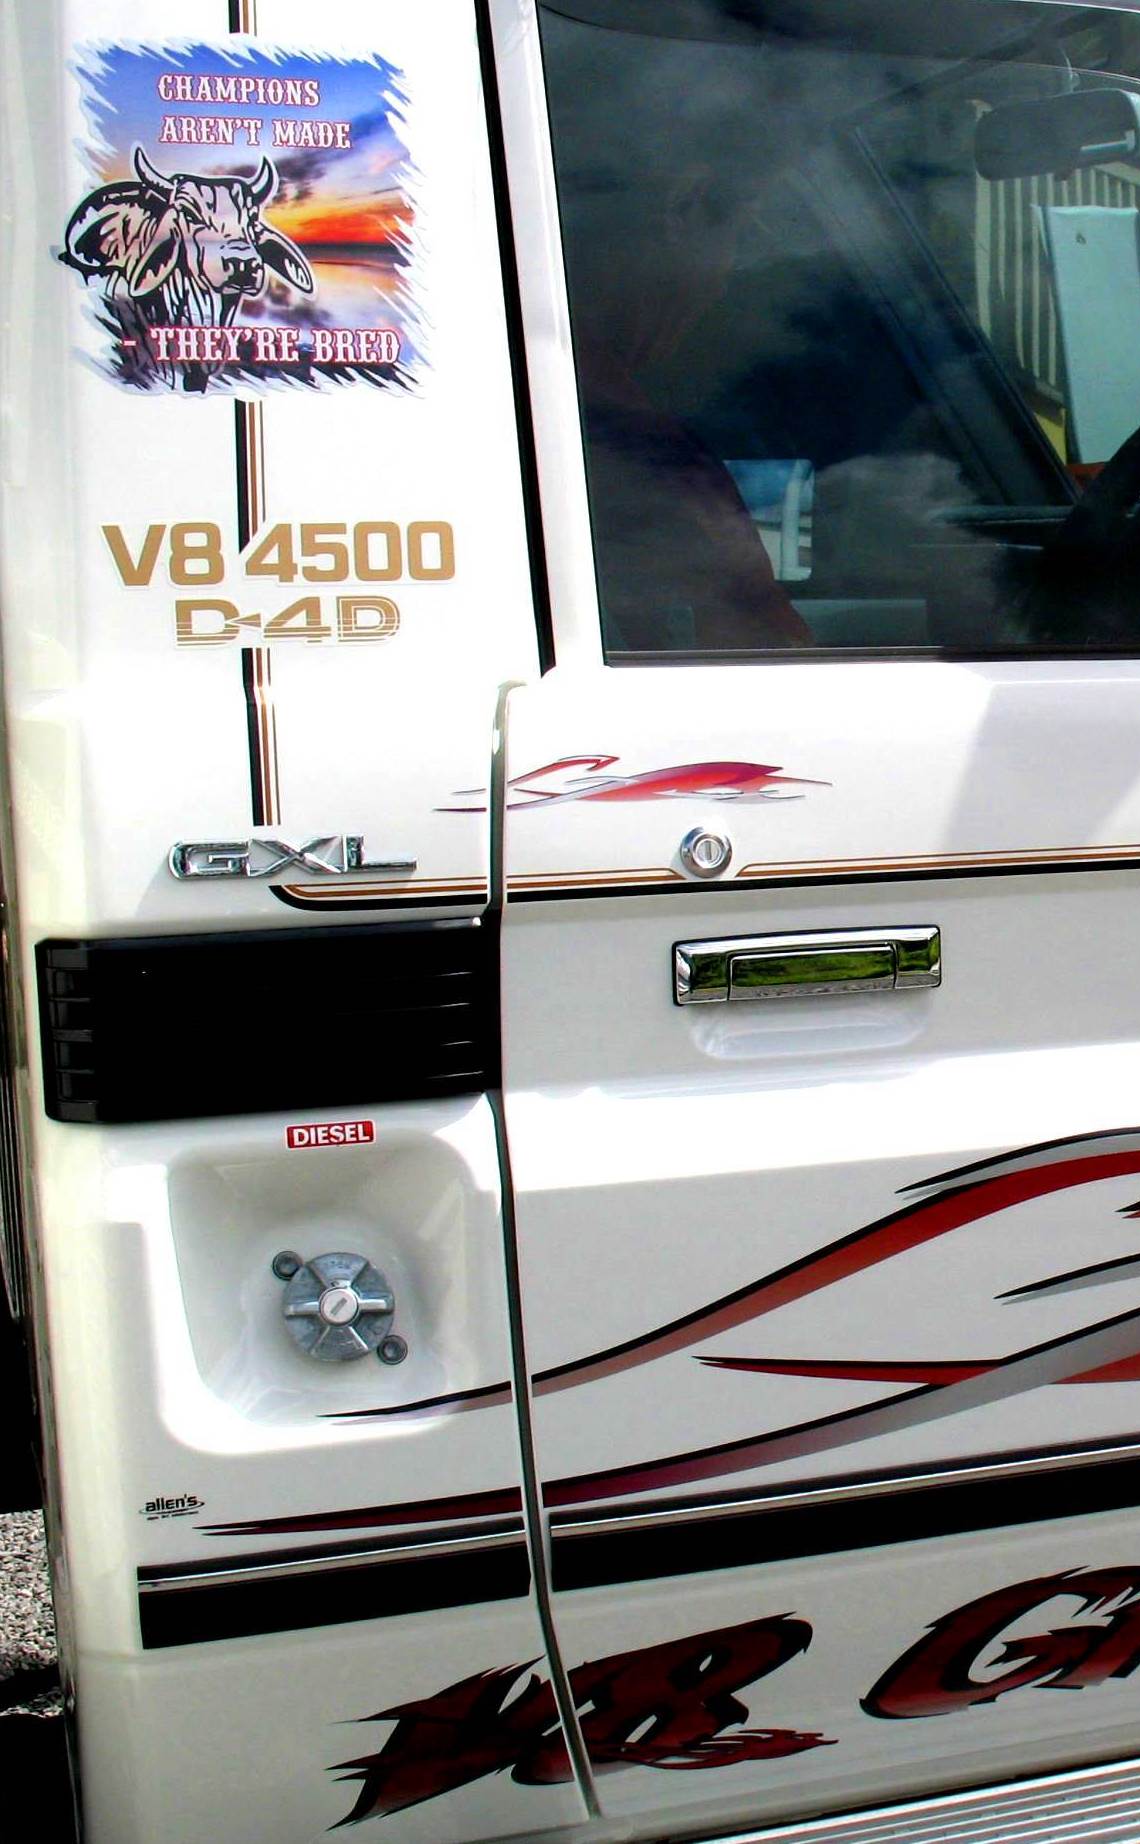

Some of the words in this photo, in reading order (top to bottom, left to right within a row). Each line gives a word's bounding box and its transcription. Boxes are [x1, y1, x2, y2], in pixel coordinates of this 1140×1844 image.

[157, 73, 321, 107] CHAMPIONS
[160, 116, 263, 147] AREN'T
[272, 120, 352, 150] MADE
[150, 327, 300, 363] THEY'RE
[311, 327, 401, 365] BRED
[101, 522, 225, 587] V8
[244, 521, 457, 583] 4500
[174, 594, 401, 647] D-4D
[168, 834, 417, 880] GXL
[292, 1120, 371, 1147] DIESEL
[145, 1493, 198, 1512] allen's
